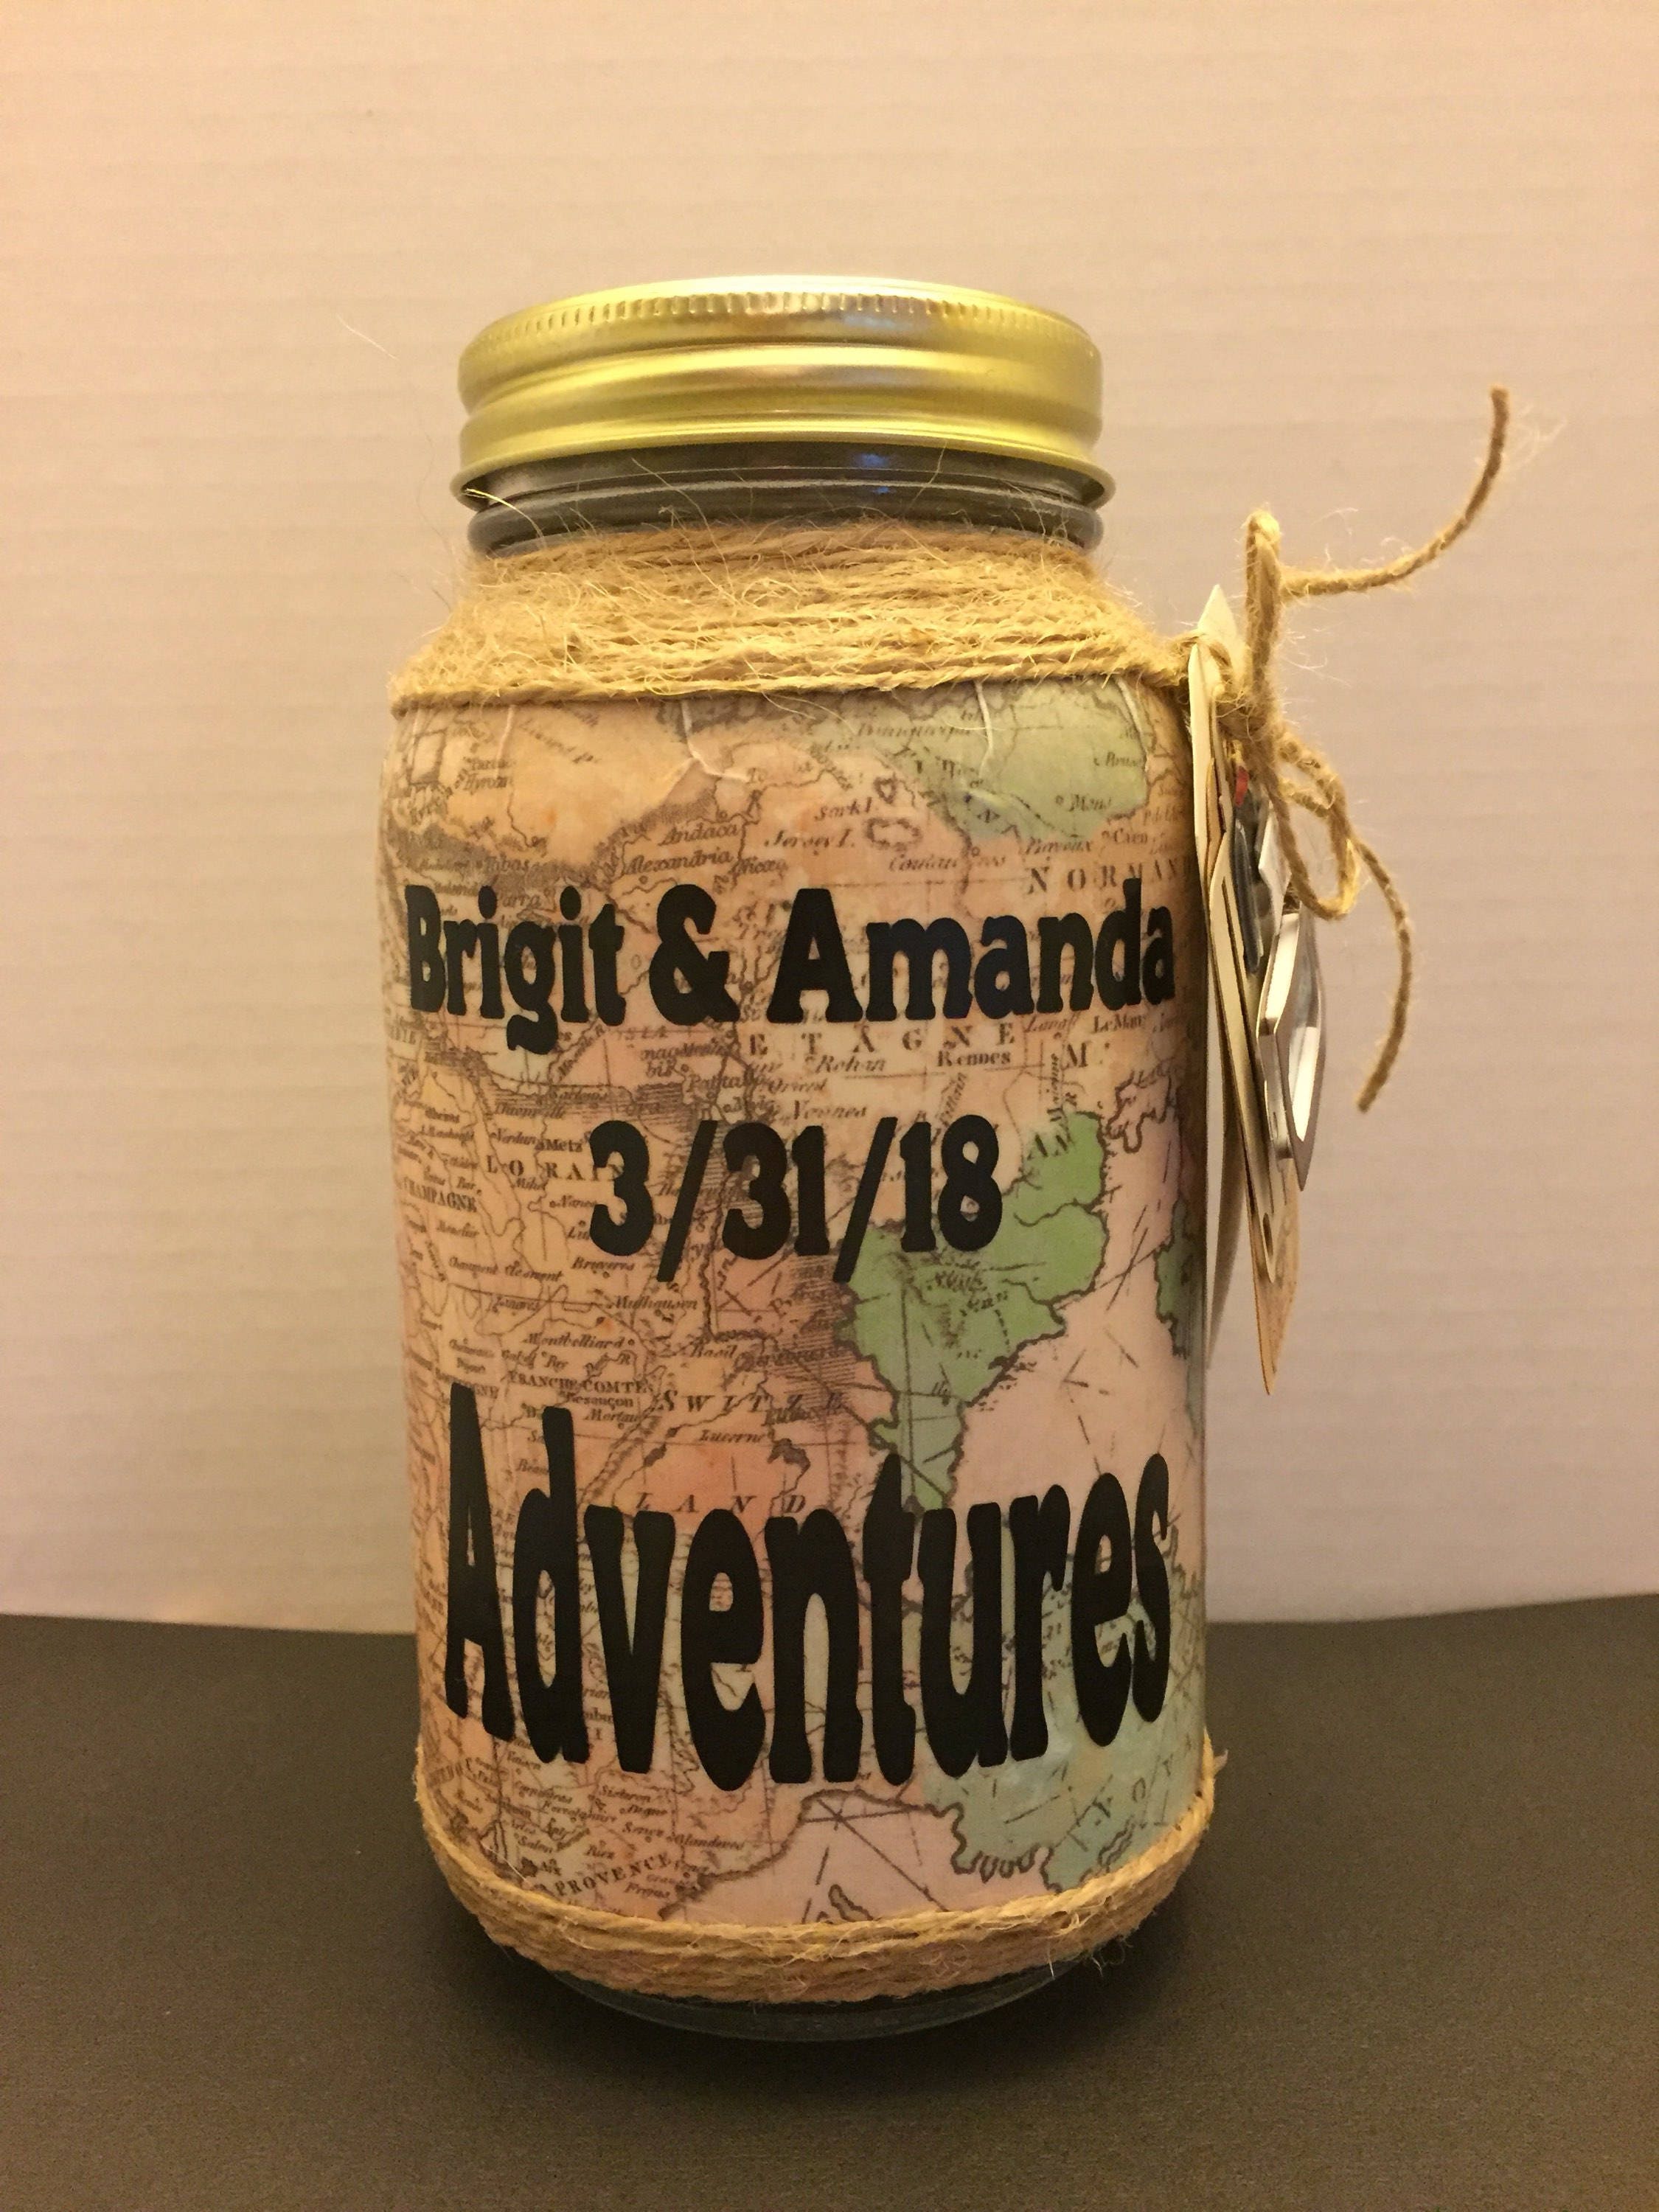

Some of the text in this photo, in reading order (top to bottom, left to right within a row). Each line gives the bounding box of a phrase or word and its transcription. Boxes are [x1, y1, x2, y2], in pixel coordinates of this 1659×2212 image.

[405, 877, 1178, 1055] Brigit & Amanda
[588, 1114, 1004, 1285] 3/31/18
[444, 1383, 1171, 1792] Adventures
